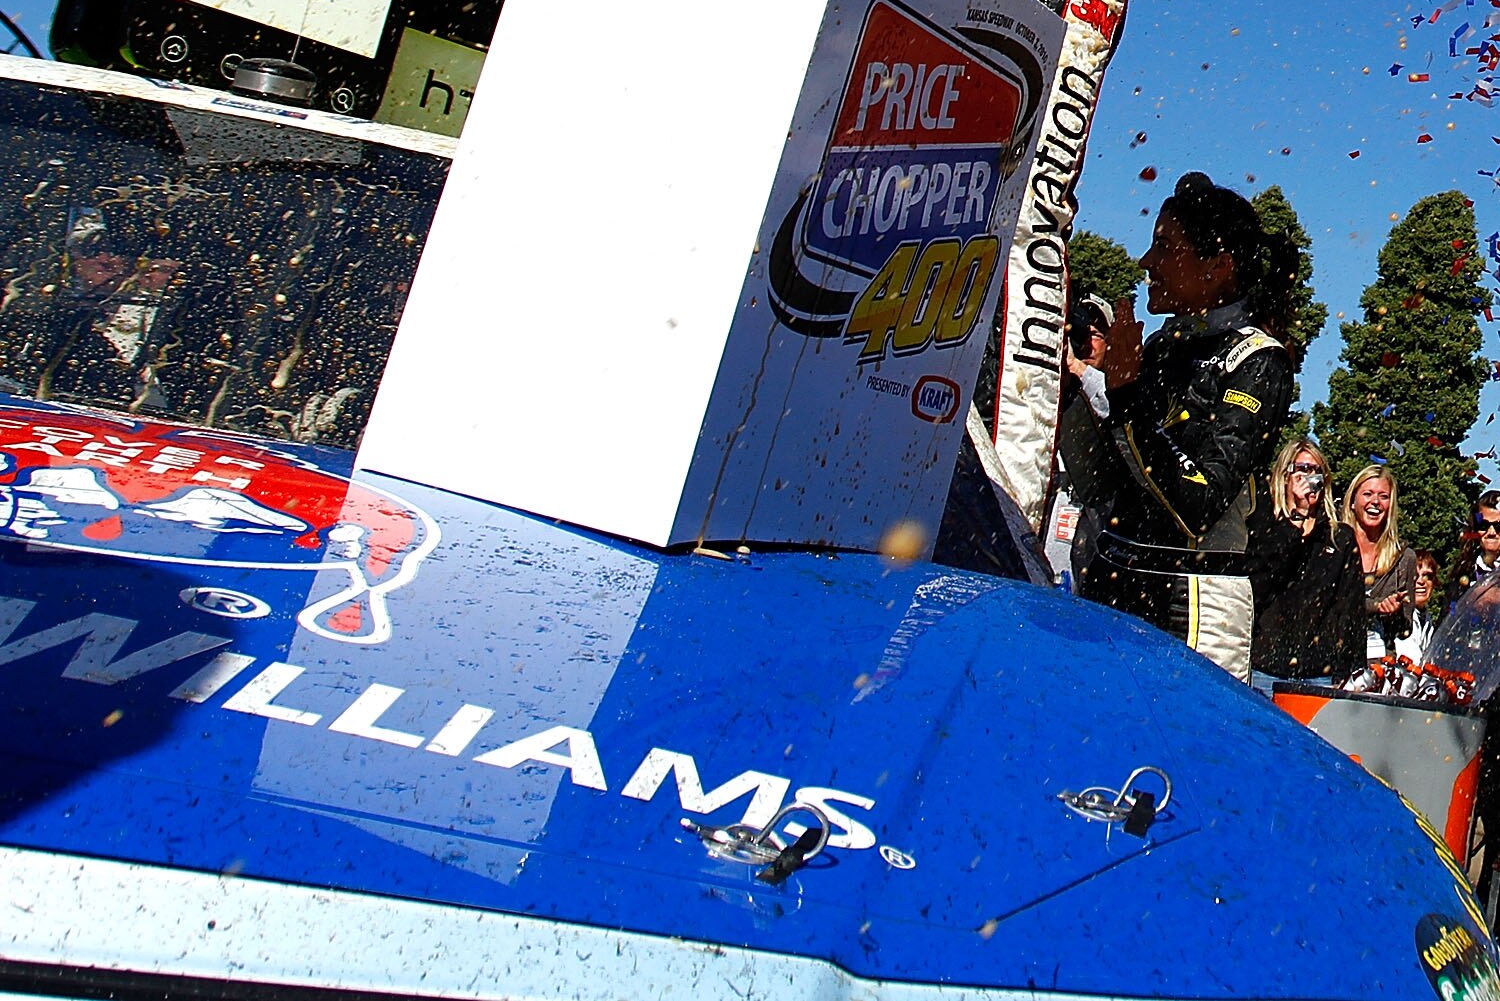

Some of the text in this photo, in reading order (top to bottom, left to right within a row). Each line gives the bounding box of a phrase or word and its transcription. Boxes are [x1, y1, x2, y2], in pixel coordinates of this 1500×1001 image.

[987, 11, 1015, 30] SPEEDWAY
[855, 61, 965, 132] PRICE
[821, 161, 992, 239] CHOPPER
[1012, 65, 1097, 374] Innovation
[843, 235, 1001, 365] 400
[866, 375, 911, 398] PRESENTED BY
[919, 386, 954, 412] KRAFT
[1226, 391, 1258, 410] SIMPSON
